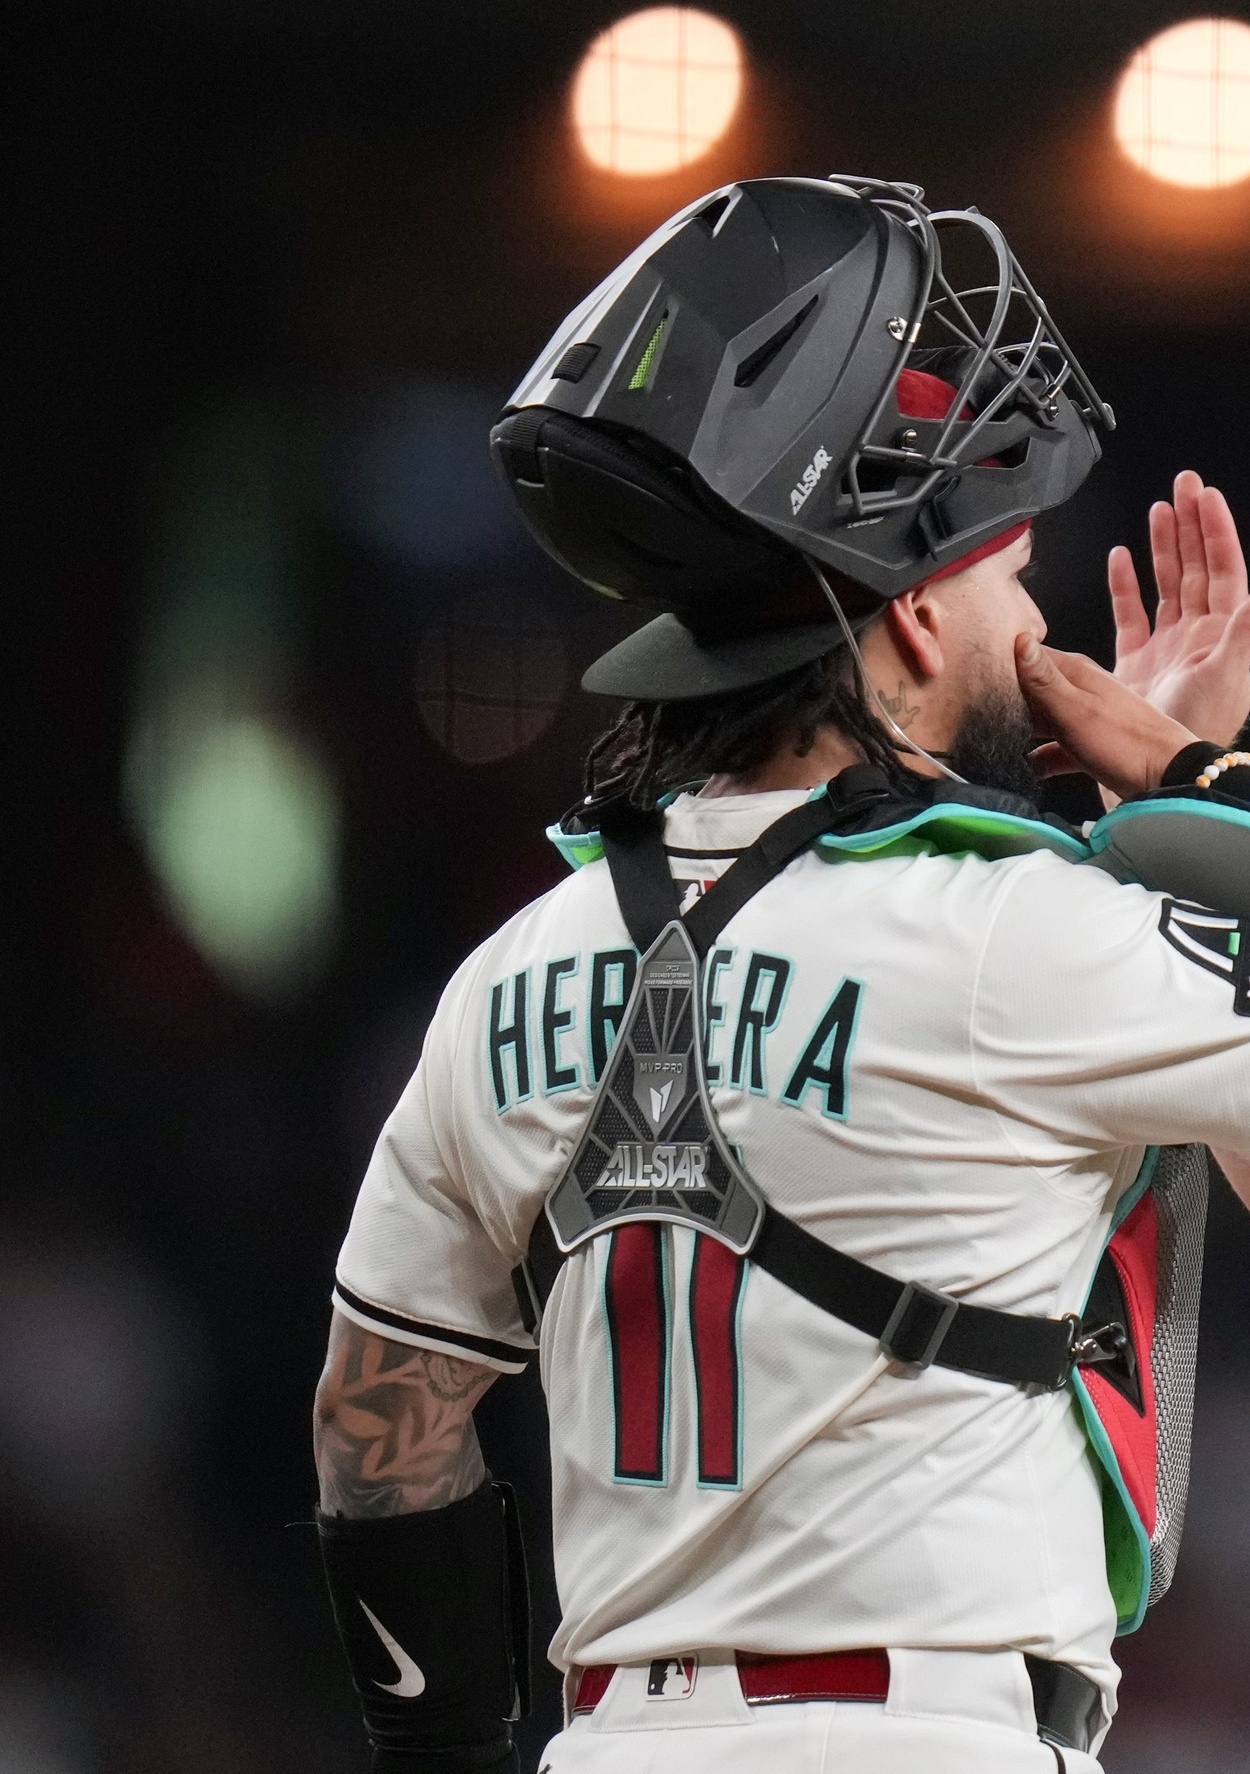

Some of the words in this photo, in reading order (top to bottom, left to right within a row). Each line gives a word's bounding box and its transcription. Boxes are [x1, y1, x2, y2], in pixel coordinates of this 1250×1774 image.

[790, 447, 833, 516] ALL-STAR
[488, 944, 866, 1122] HERERA
[639, 1061, 684, 1075] MVP-PRO
[596, 1145, 707, 1188] ALL-STAR
